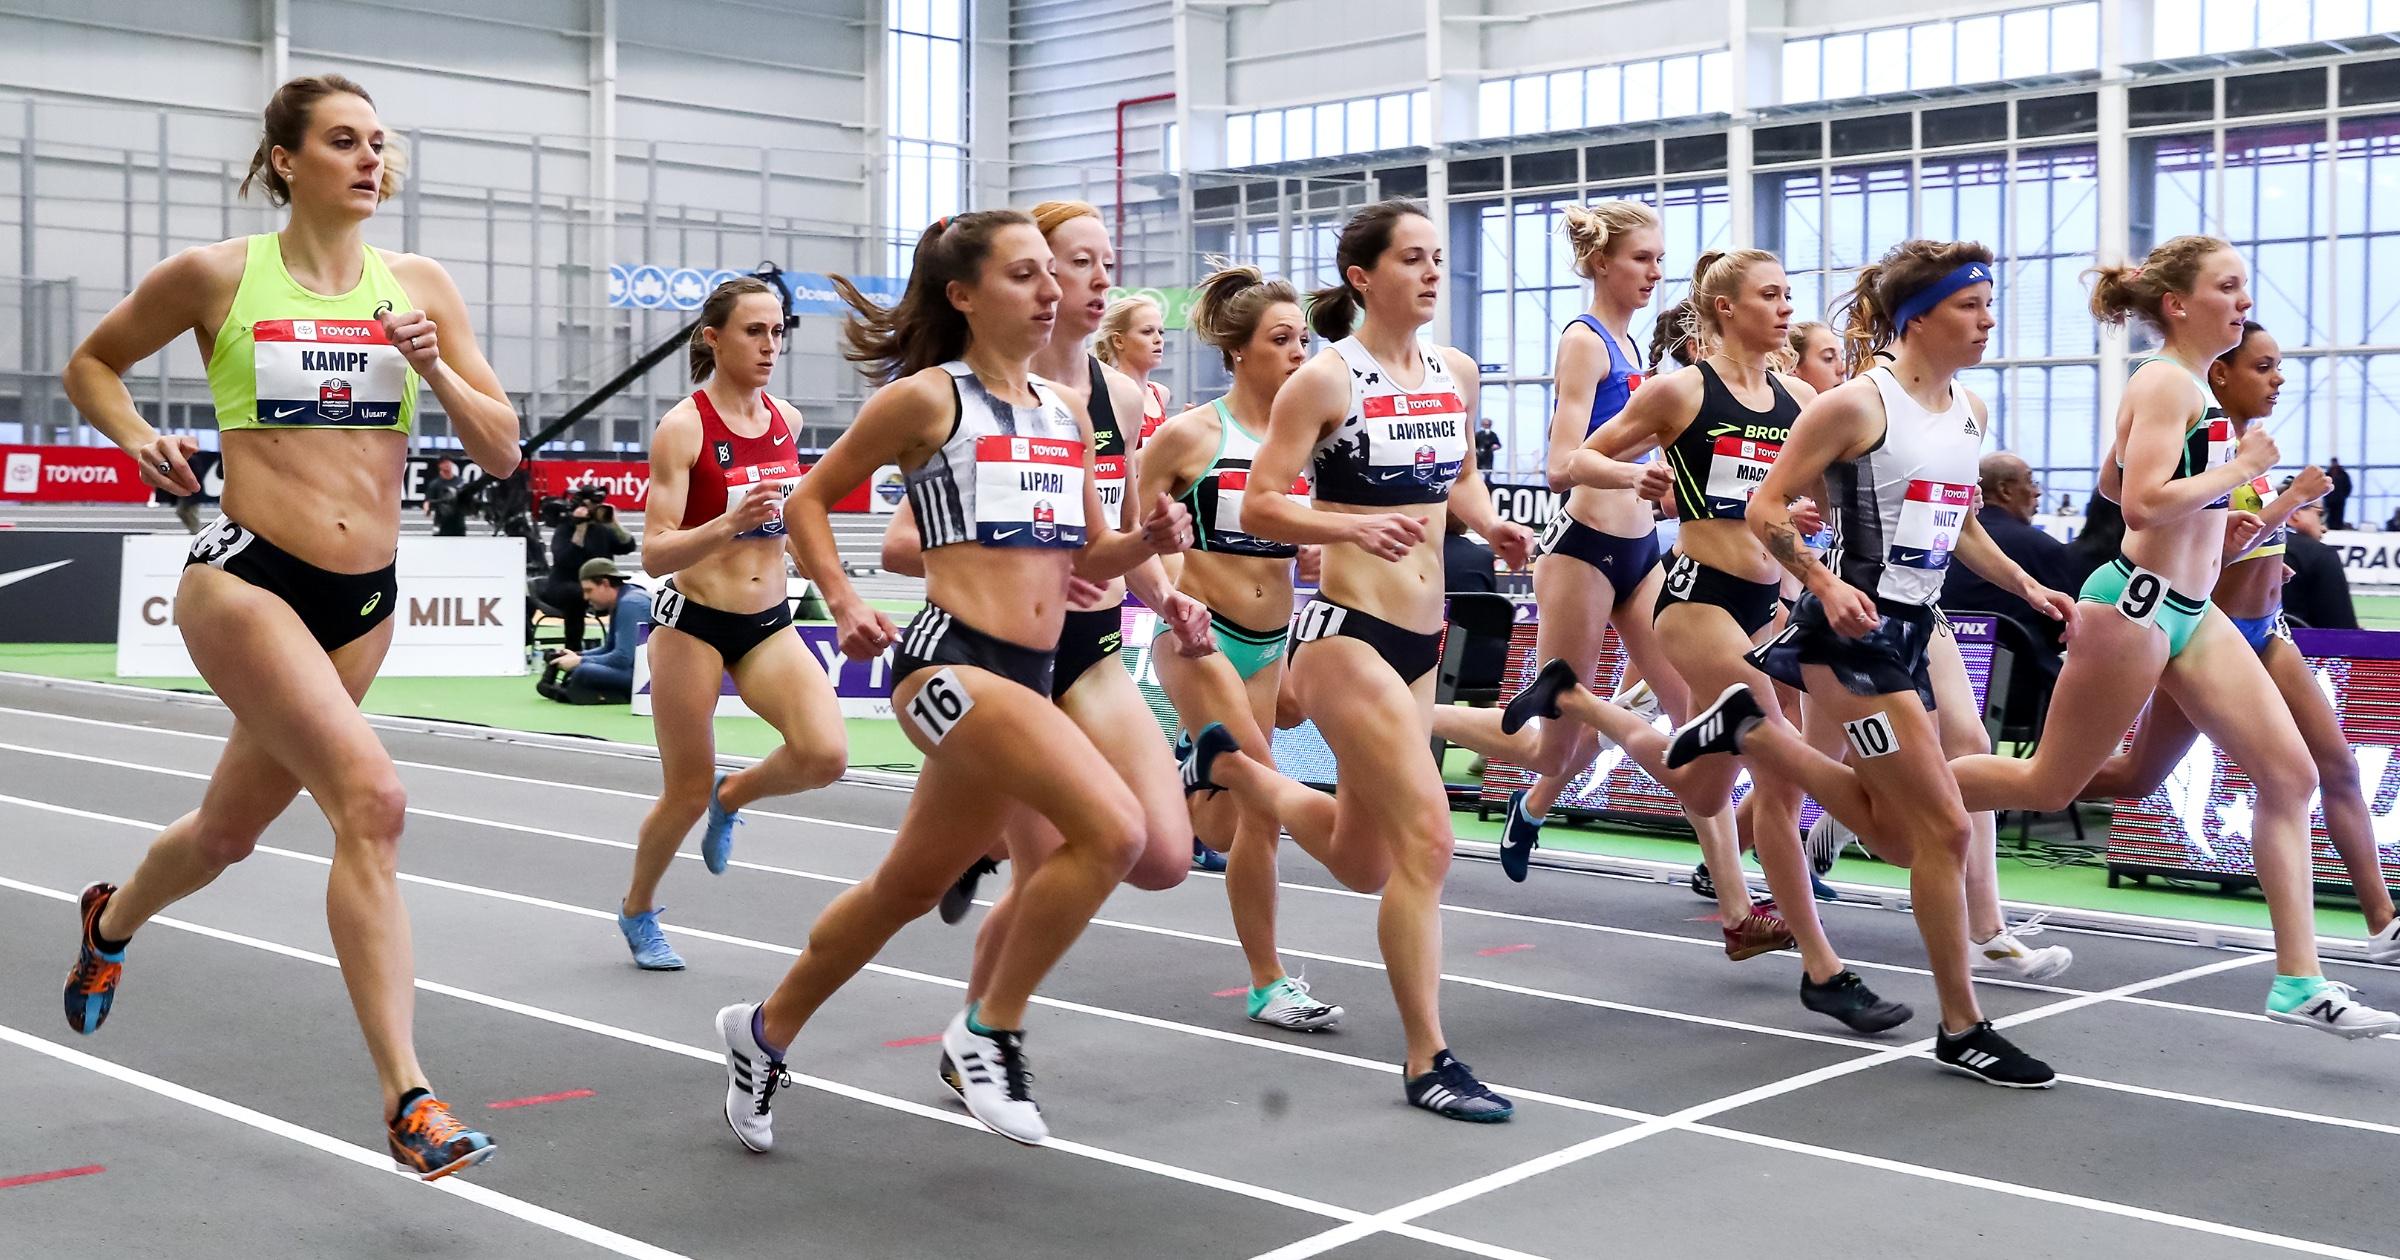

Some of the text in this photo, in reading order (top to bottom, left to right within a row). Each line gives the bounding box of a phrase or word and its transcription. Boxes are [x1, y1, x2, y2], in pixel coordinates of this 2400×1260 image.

[320, 326, 371, 337] TOYOTA
[302, 350, 368, 372] KAMPF
[1408, 399, 1442, 409] TOYOTA
[1388, 420, 1456, 440] LAWRENCE
[1744, 424, 1790, 441] BROO
[1031, 444, 1070, 457] TOYOTA
[1757, 447, 1780, 459] TOYOT
[45, 465, 118, 483] TOYOTA
[760, 465, 787, 476] TOYOTA
[1094, 462, 1117, 473] YOTA
[1020, 471, 1064, 494] LIPARI
[1943, 489, 1969, 500] TOYOTA
[1933, 510, 1959, 528] HILTZ
[654, 587, 680, 623] 14
[2122, 574, 2160, 618] 9
[409, 597, 503, 627] MILK
[1301, 606, 1335, 639] 11
[1952, 622, 1989, 635] YNX
[913, 677, 962, 737] 16
[1848, 718, 1890, 756] 10
